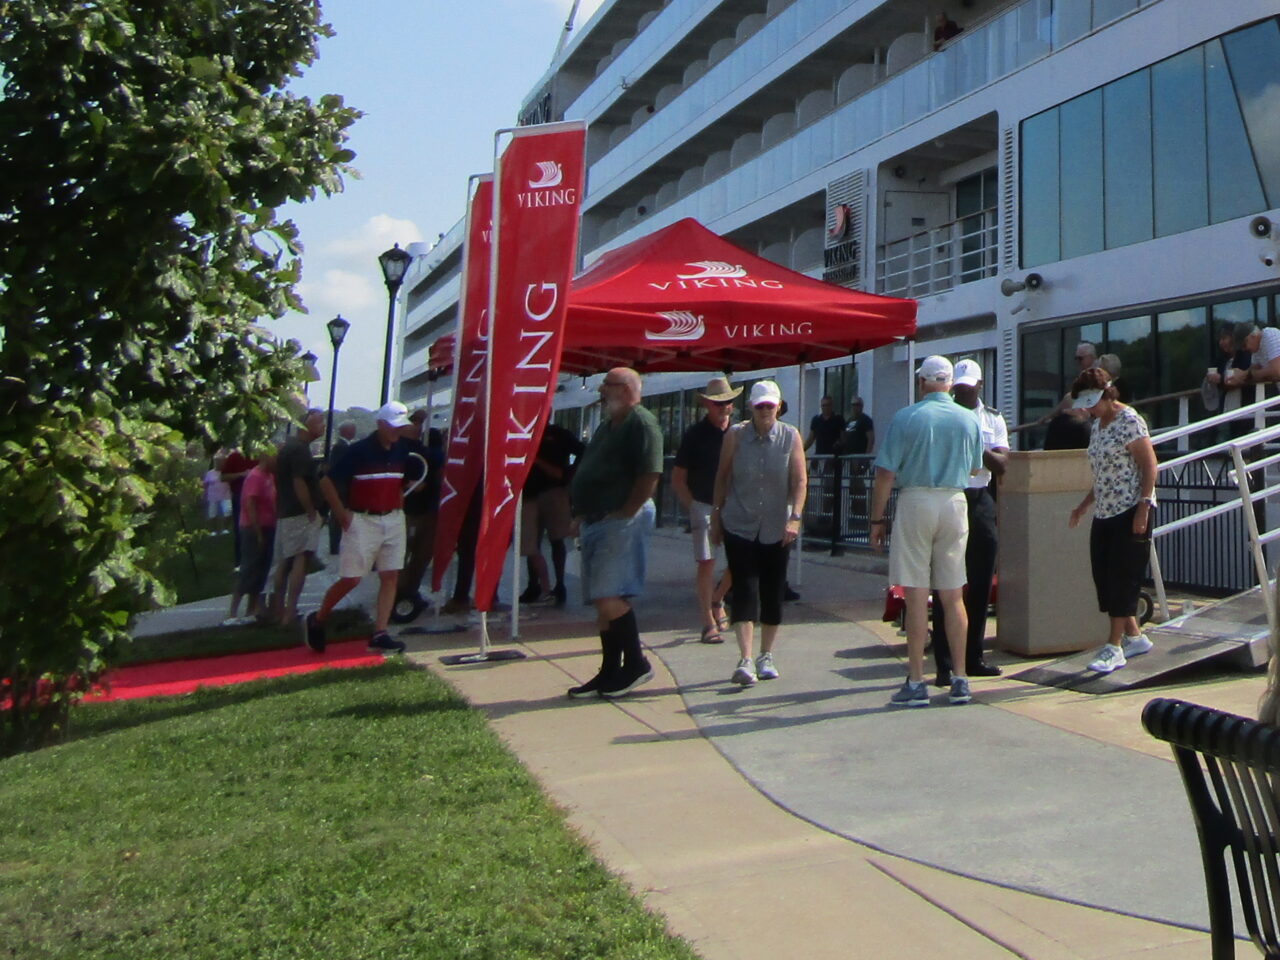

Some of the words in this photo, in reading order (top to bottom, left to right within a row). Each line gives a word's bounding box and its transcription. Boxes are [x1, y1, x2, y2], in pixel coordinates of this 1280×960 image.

[517, 188, 576, 208] VIKING
[647, 278, 784, 291] VIKING
[725, 322, 812, 339] VIKING
[494, 281, 558, 517] VIKING
